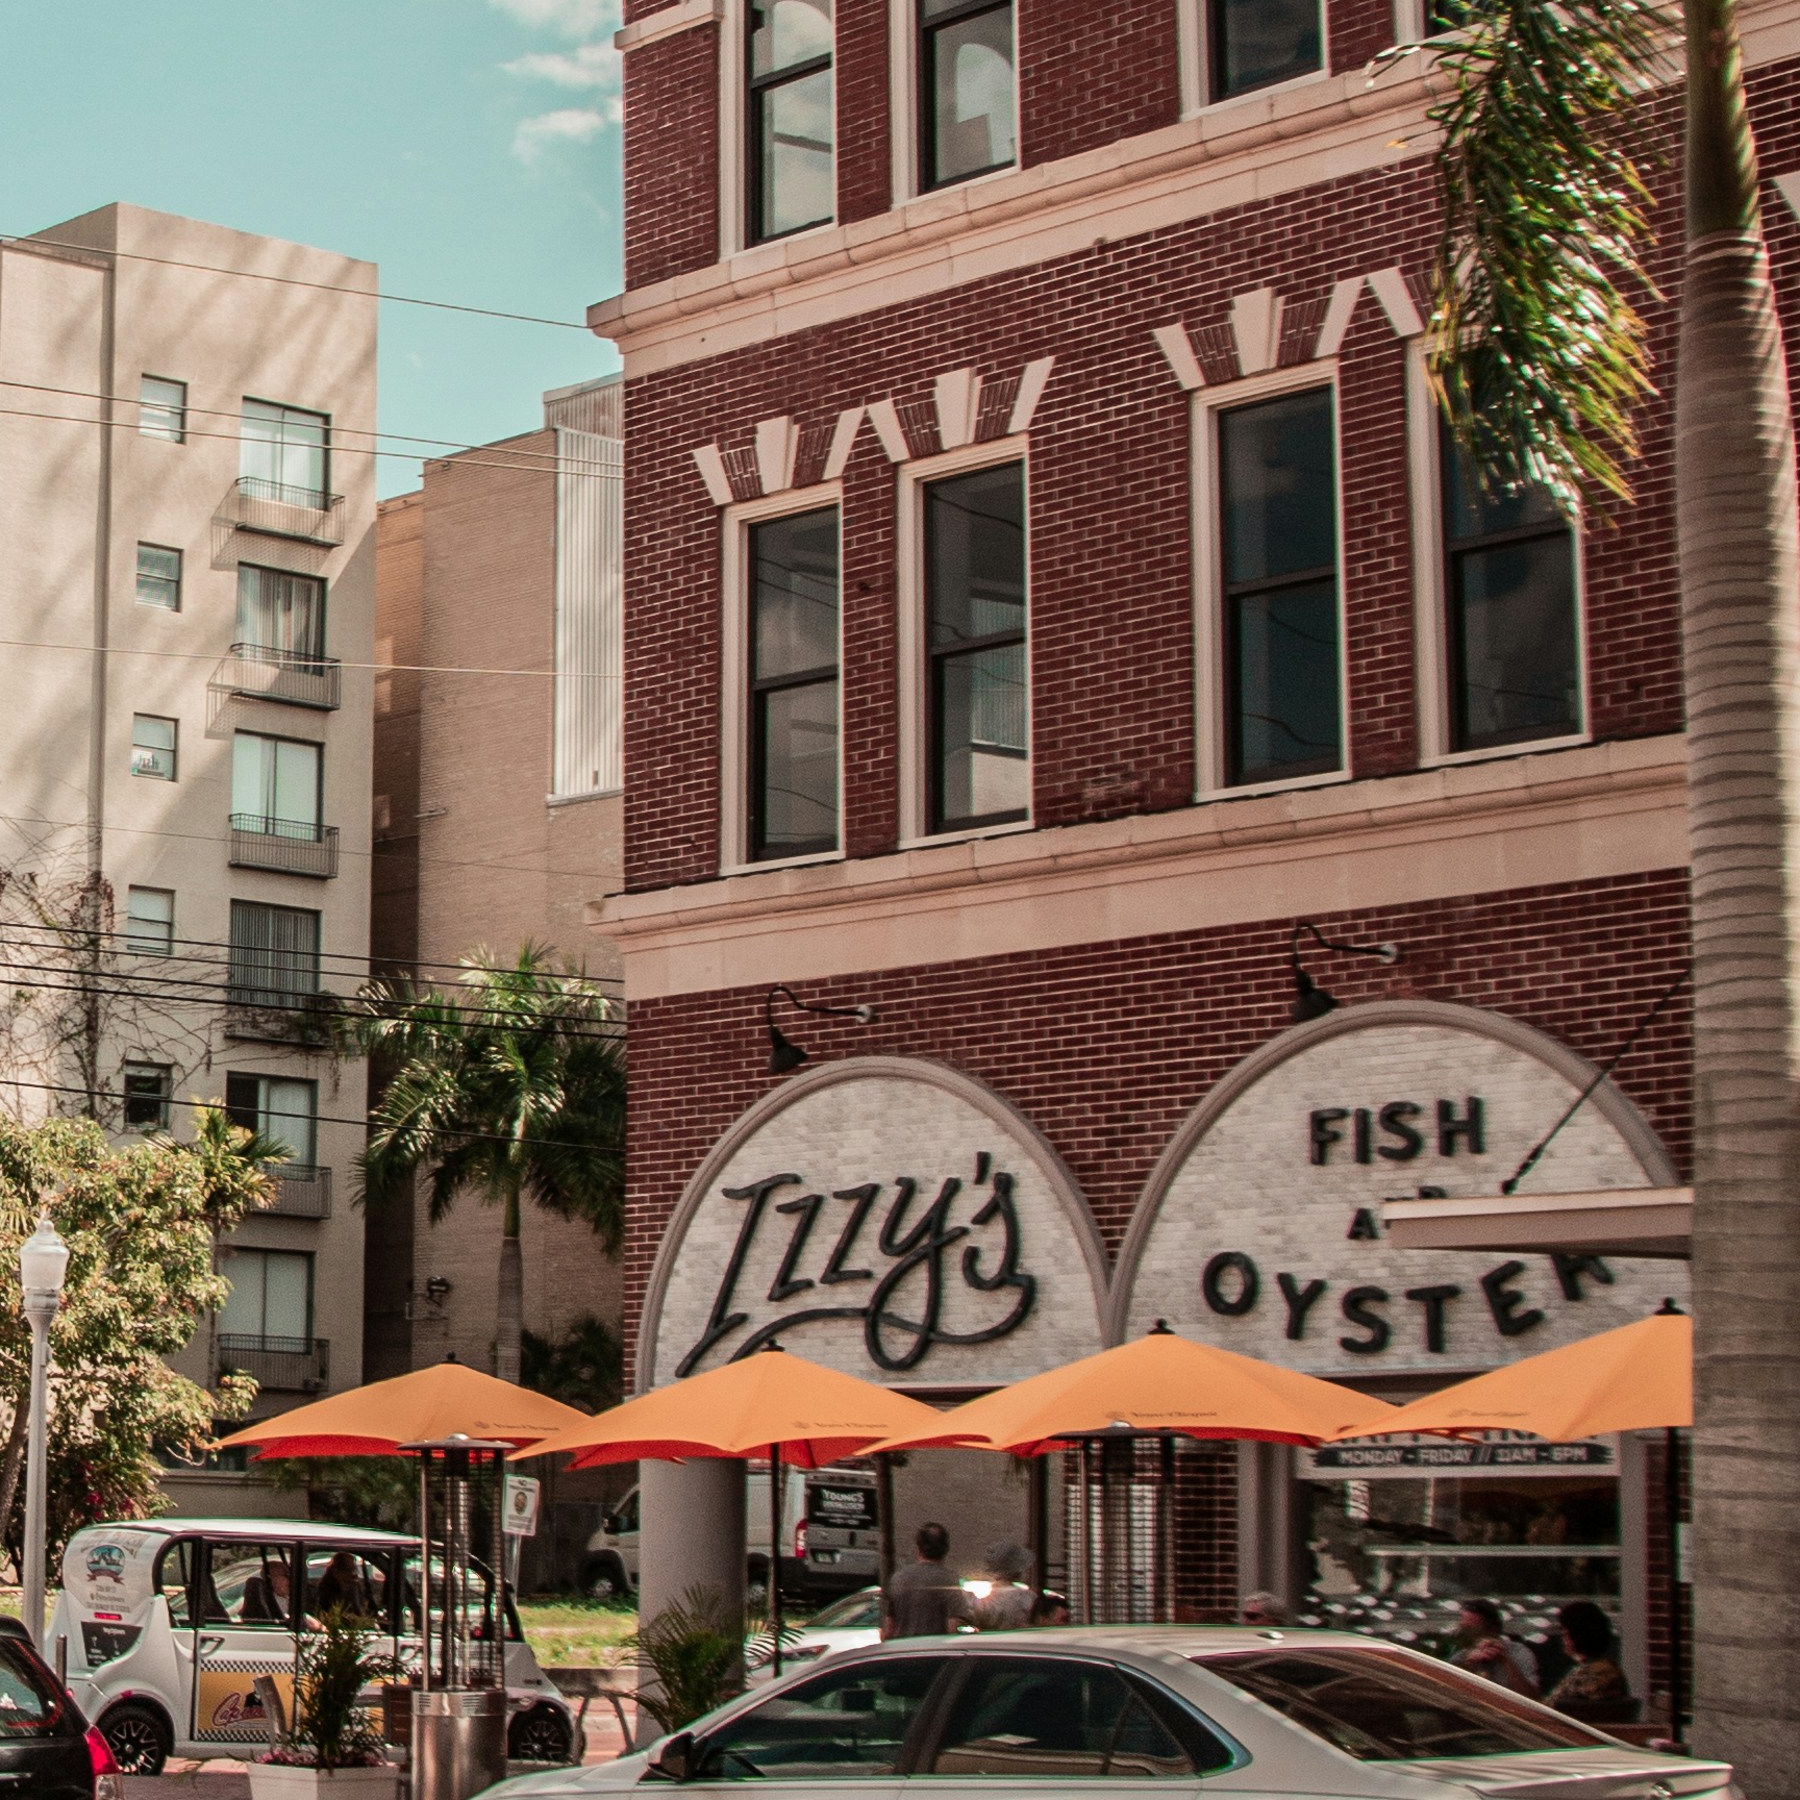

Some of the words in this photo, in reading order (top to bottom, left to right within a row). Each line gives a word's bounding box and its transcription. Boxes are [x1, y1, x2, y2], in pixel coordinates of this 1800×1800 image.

[1309, 1096, 1486, 1166] FISH
[675, 1151, 1037, 1379] Izzy's
[1339, 1449, 1404, 1465] MONDAY
[1419, 1448, 1474, 1463] FRIDAY
